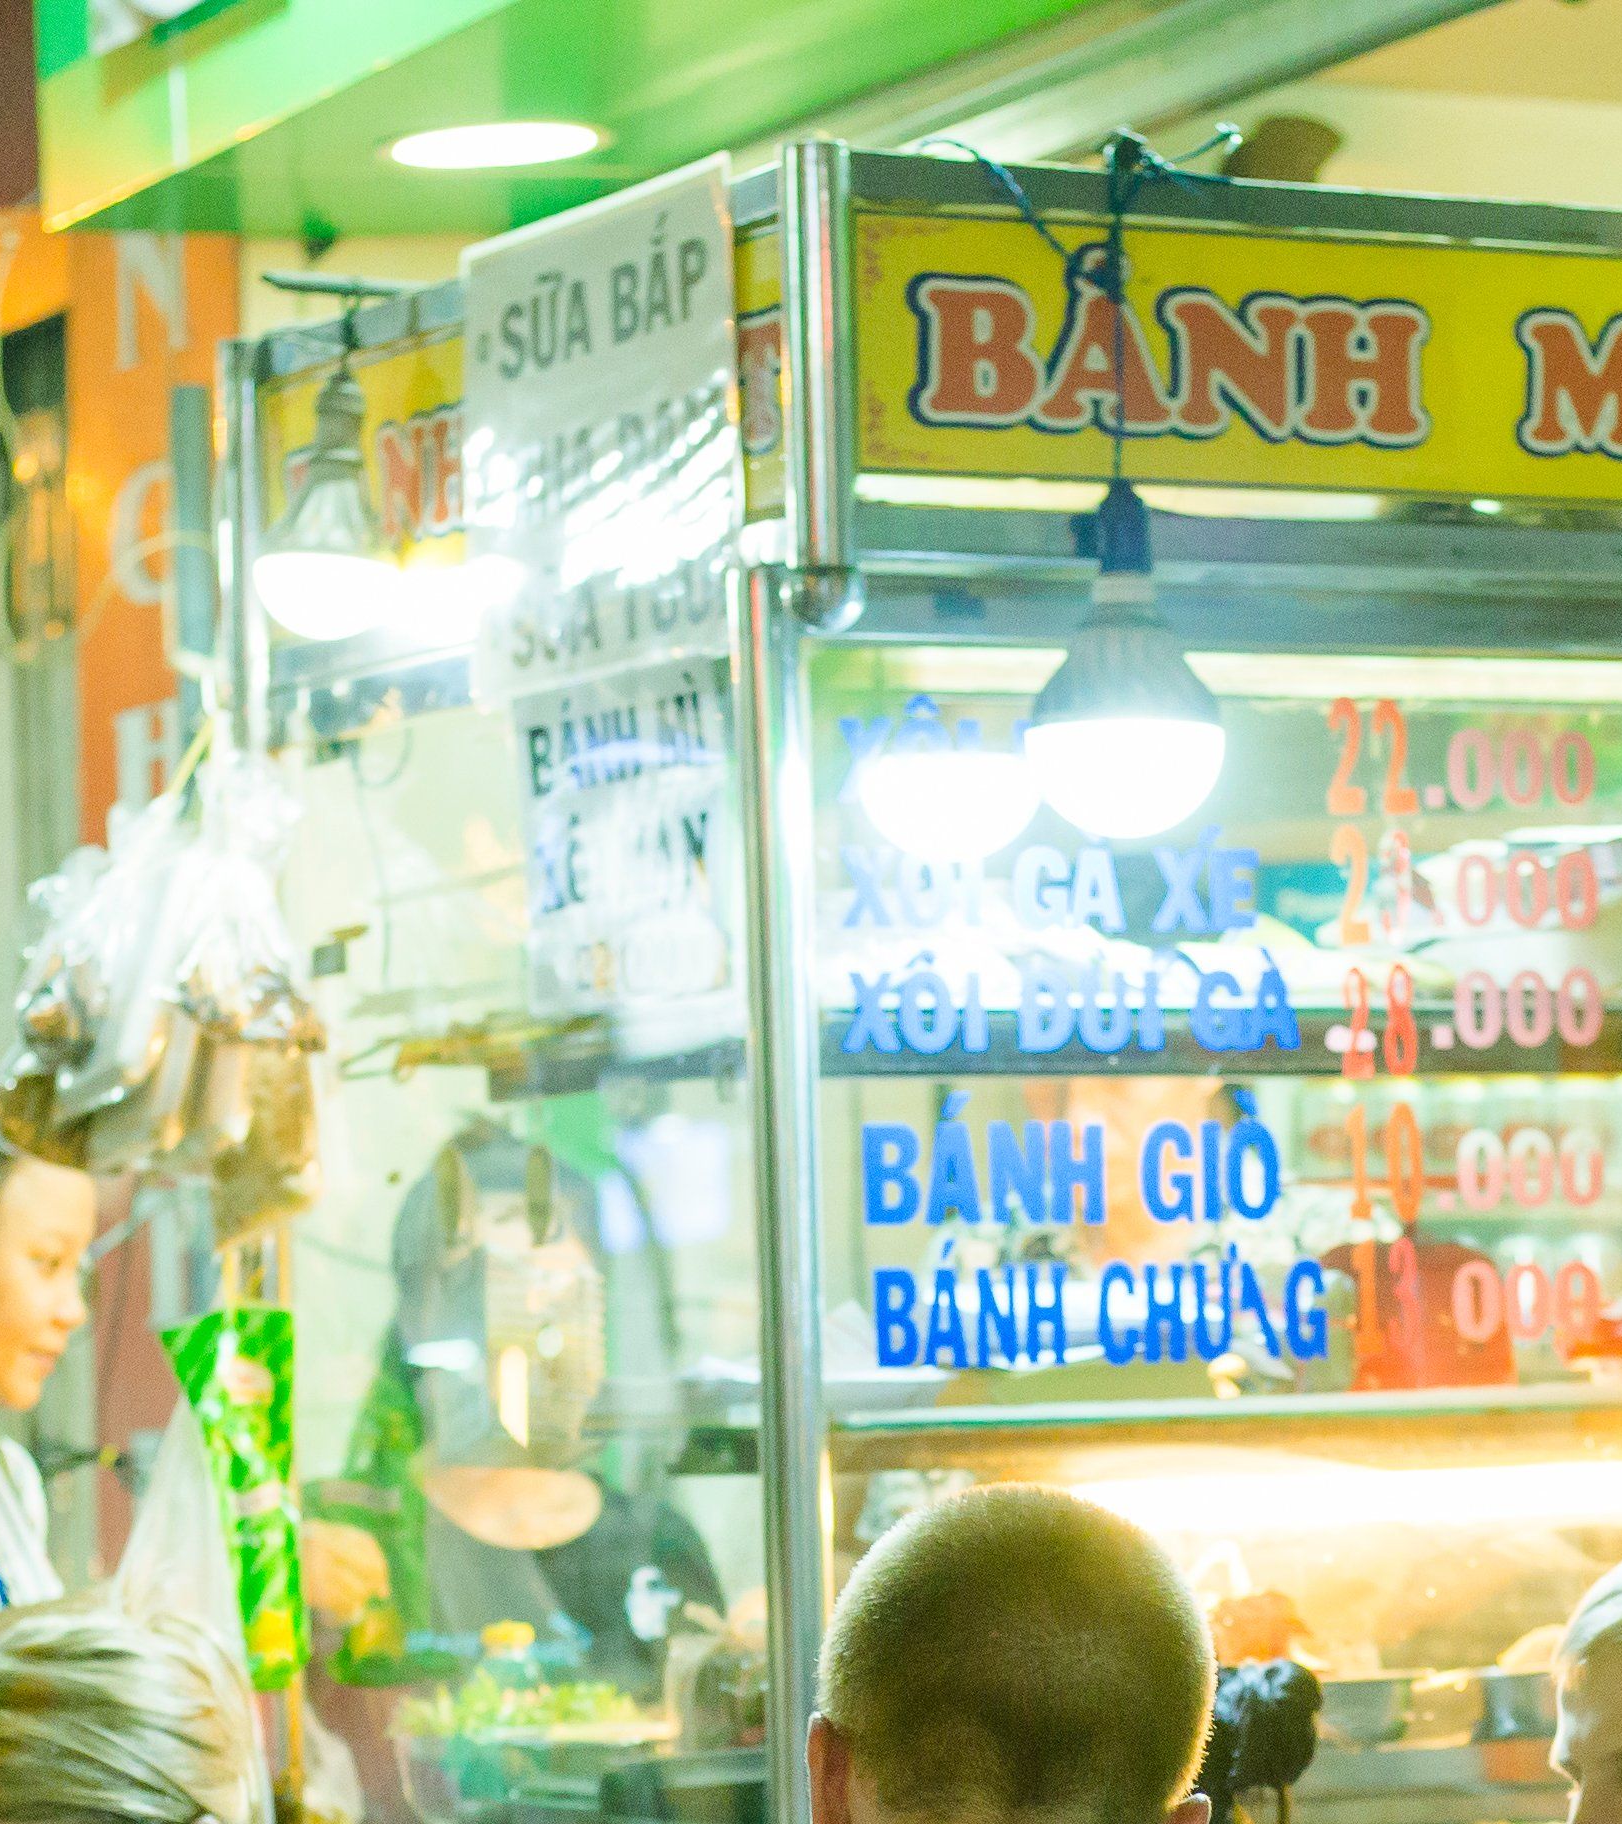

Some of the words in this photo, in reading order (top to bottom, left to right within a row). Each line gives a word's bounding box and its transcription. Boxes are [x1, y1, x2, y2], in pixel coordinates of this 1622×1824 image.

[497, 266, 592, 380] SỮA
[609, 210, 711, 346] BẮP
[1325, 696, 1597, 816] 22.000
[1149, 822, 1261, 934] XÉ
[839, 948, 991, 1055] XÔI
[1187, 944, 1303, 1053] GÀ
[1339, 962, 1605, 1080] 28.000
[861, 1088, 1109, 1226] BÁNH
[1139, 1088, 1283, 1226] GIÒ
[1343, 1101, 1606, 1224] 10.000
[871, 1238, 1069, 1370] BÁNH
